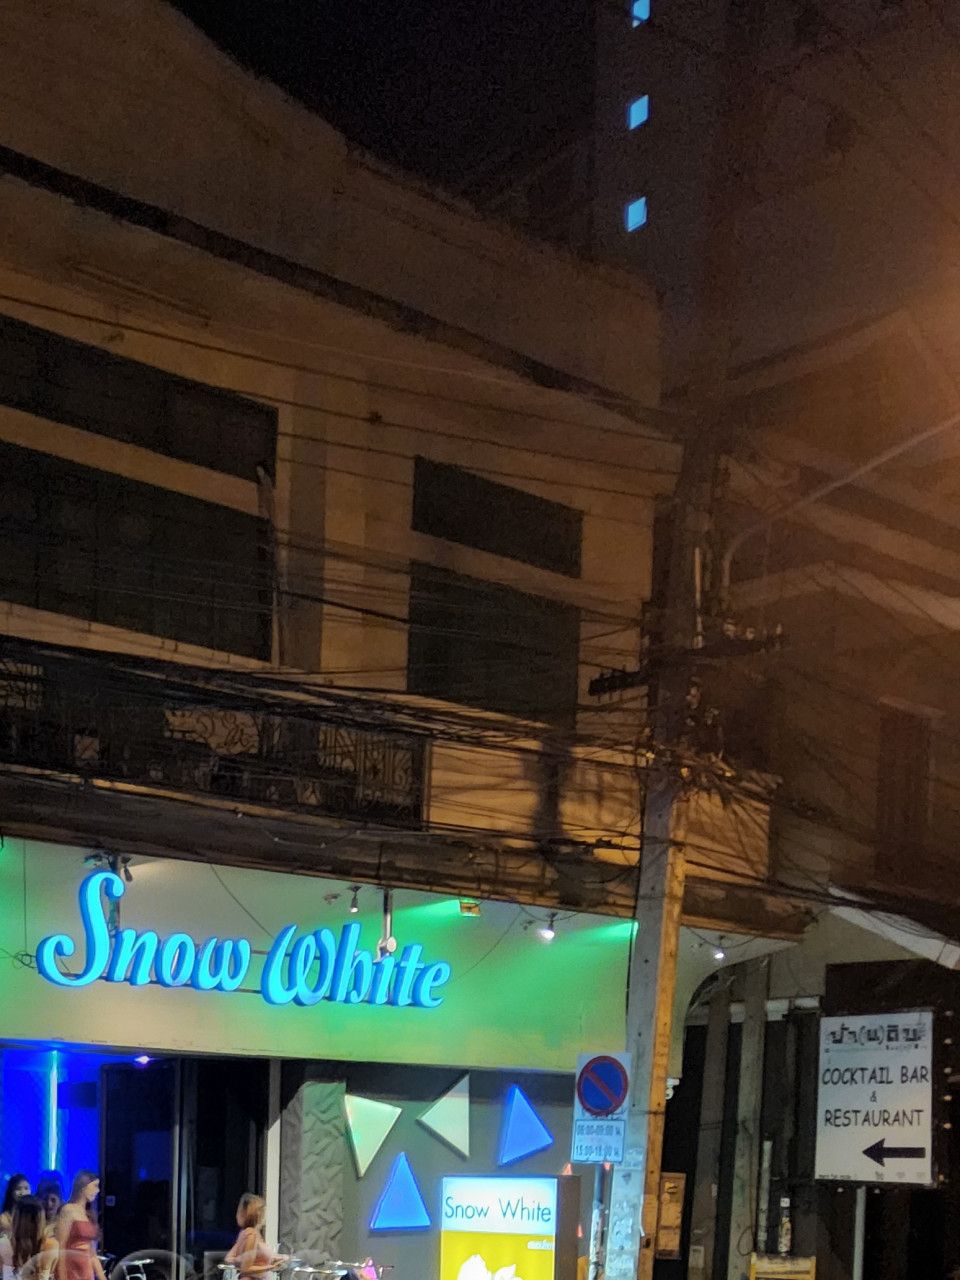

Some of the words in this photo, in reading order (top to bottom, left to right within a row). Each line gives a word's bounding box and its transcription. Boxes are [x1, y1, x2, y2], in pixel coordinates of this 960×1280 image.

[36, 868, 251, 991] Snow
[260, 922, 452, 1008] White
[822, 1067, 893, 1086] COCKTAIL
[900, 1065, 930, 1085] BAR
[869, 1090, 878, 1103] &
[824, 1108, 925, 1128] RESTAURANT
[444, 1195, 490, 1220] Snow
[499, 1196, 553, 1223] White
